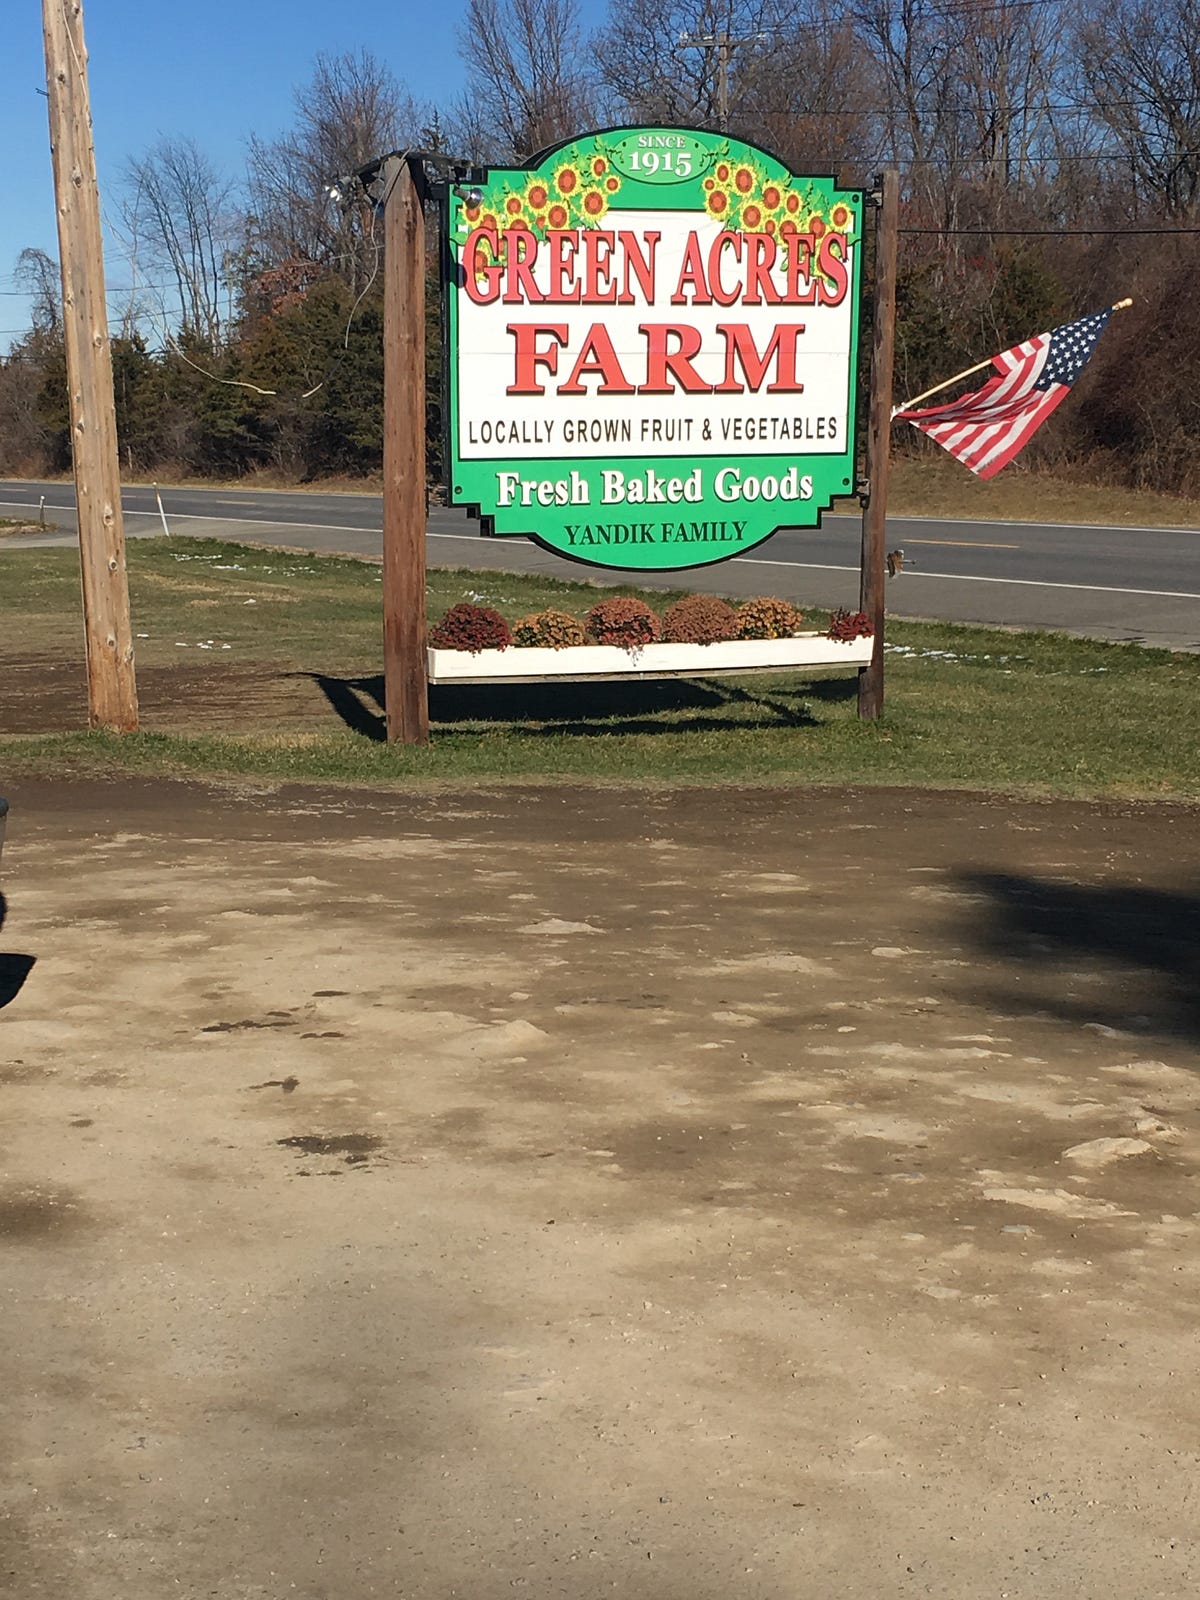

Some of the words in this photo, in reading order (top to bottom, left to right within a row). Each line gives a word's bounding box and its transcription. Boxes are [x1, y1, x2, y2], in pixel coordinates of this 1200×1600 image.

[638, 135, 686, 148] SINCE
[629, 151, 692, 177] 1915
[462, 227, 661, 305] GREEN
[671, 230, 849, 306] ACRES
[506, 323, 806, 395] FARM
[468, 419, 555, 444] LOCALLY
[563, 418, 632, 443] GROWN
[640, 417, 694, 442] FRUIT
[702, 418, 713, 441] &
[721, 416, 838, 440] VEGETABLES
[496, 470, 590, 507] Fresh
[600, 468, 703, 504] Baked
[714, 466, 814, 503] Goods
[564, 523, 656, 546] YANDIK
[660, 520, 748, 544] FAMILY
